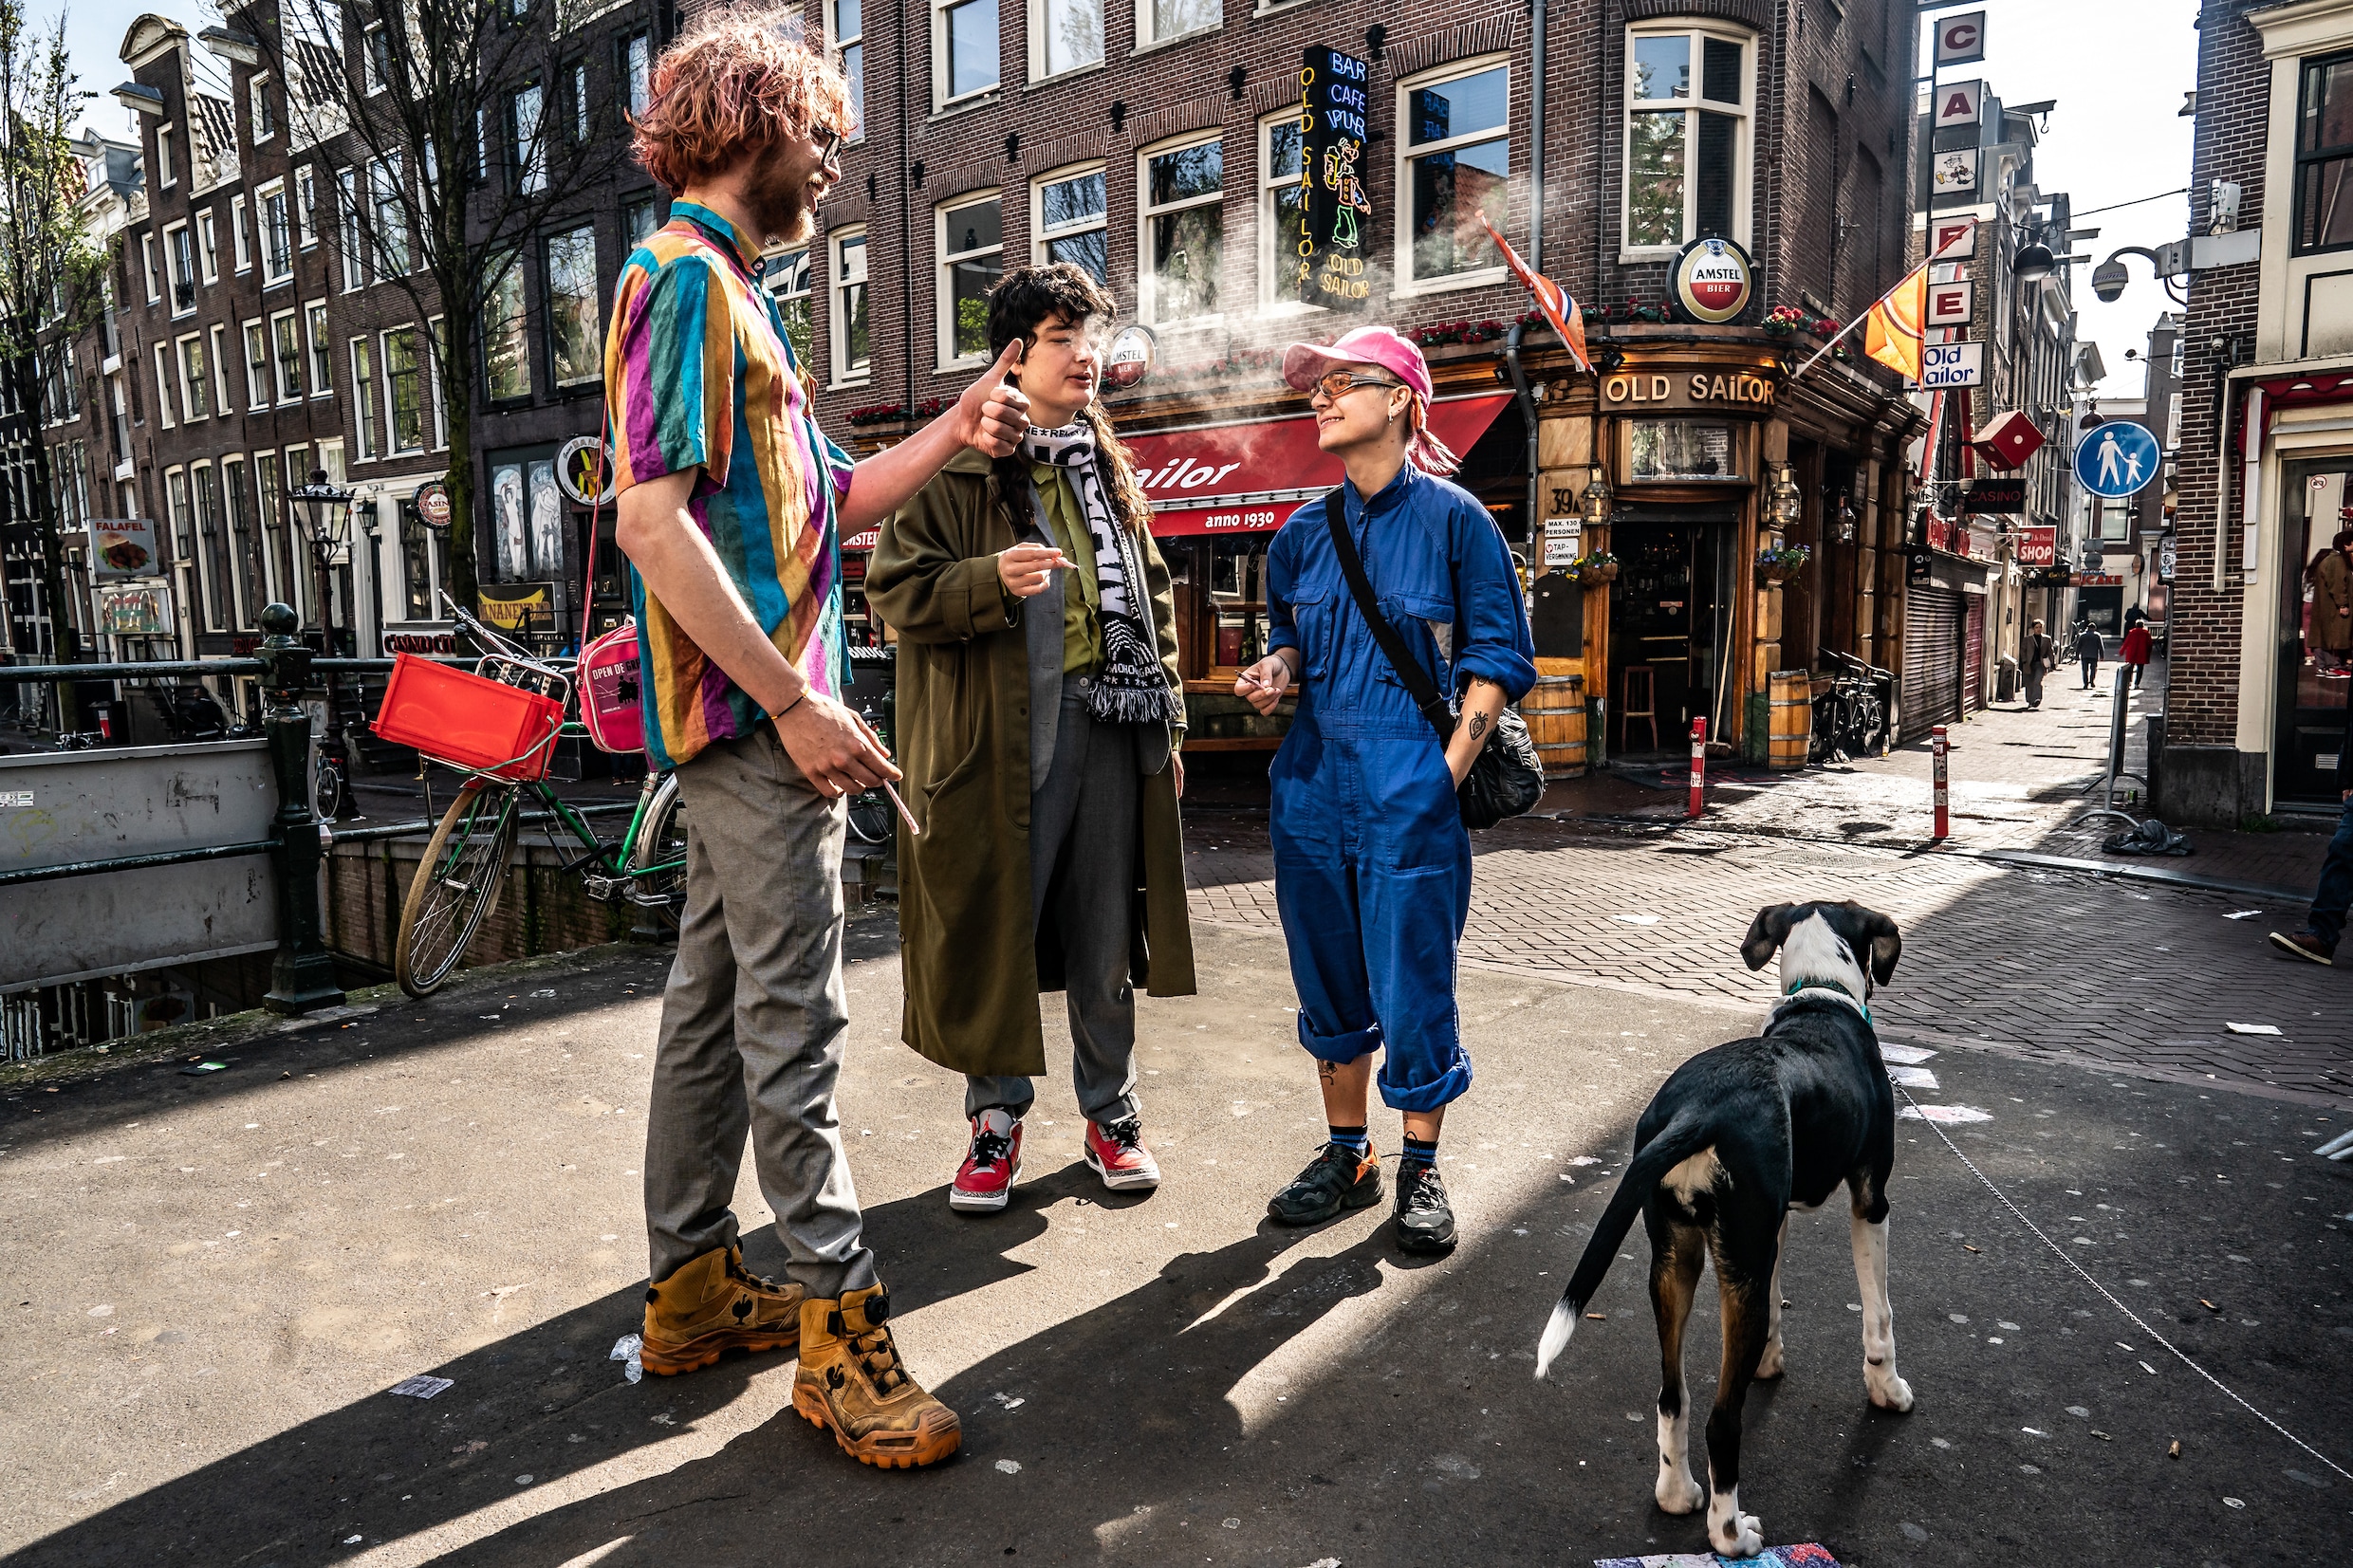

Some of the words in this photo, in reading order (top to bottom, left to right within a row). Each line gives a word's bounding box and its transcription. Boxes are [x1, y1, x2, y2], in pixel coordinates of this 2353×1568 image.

[1331, 52, 1366, 82] BAR
[1300, 66, 1315, 133] OLD
[1330, 83, 1366, 113] CAFE
[1298, 145, 1314, 281] SAILOR
[1328, 253, 1363, 276] OLD
[1695, 268, 1741, 280] AMSTEL
[1320, 273, 1370, 299] SAILOR
[1707, 285, 1731, 293] BIER
[1924, 345, 1962, 367] Old
[1118, 364, 1133, 374] BIER
[1909, 365, 1974, 387] ailor
[1605, 375, 1671, 402] OLD
[1135, 457, 1242, 489] ailor
[419, 500, 451, 509] CASIN
[1969, 490, 2022, 503] CASINO
[96, 522, 146, 531] FALAFEL
[1204, 513, 1240, 528] anno
[1244, 510, 1275, 529] 1930
[2020, 545, 2052, 561] SHOP
[433, 635, 457, 655] CIT
[592, 665, 614, 681] OPEN
[615, 662, 625, 675] DE
